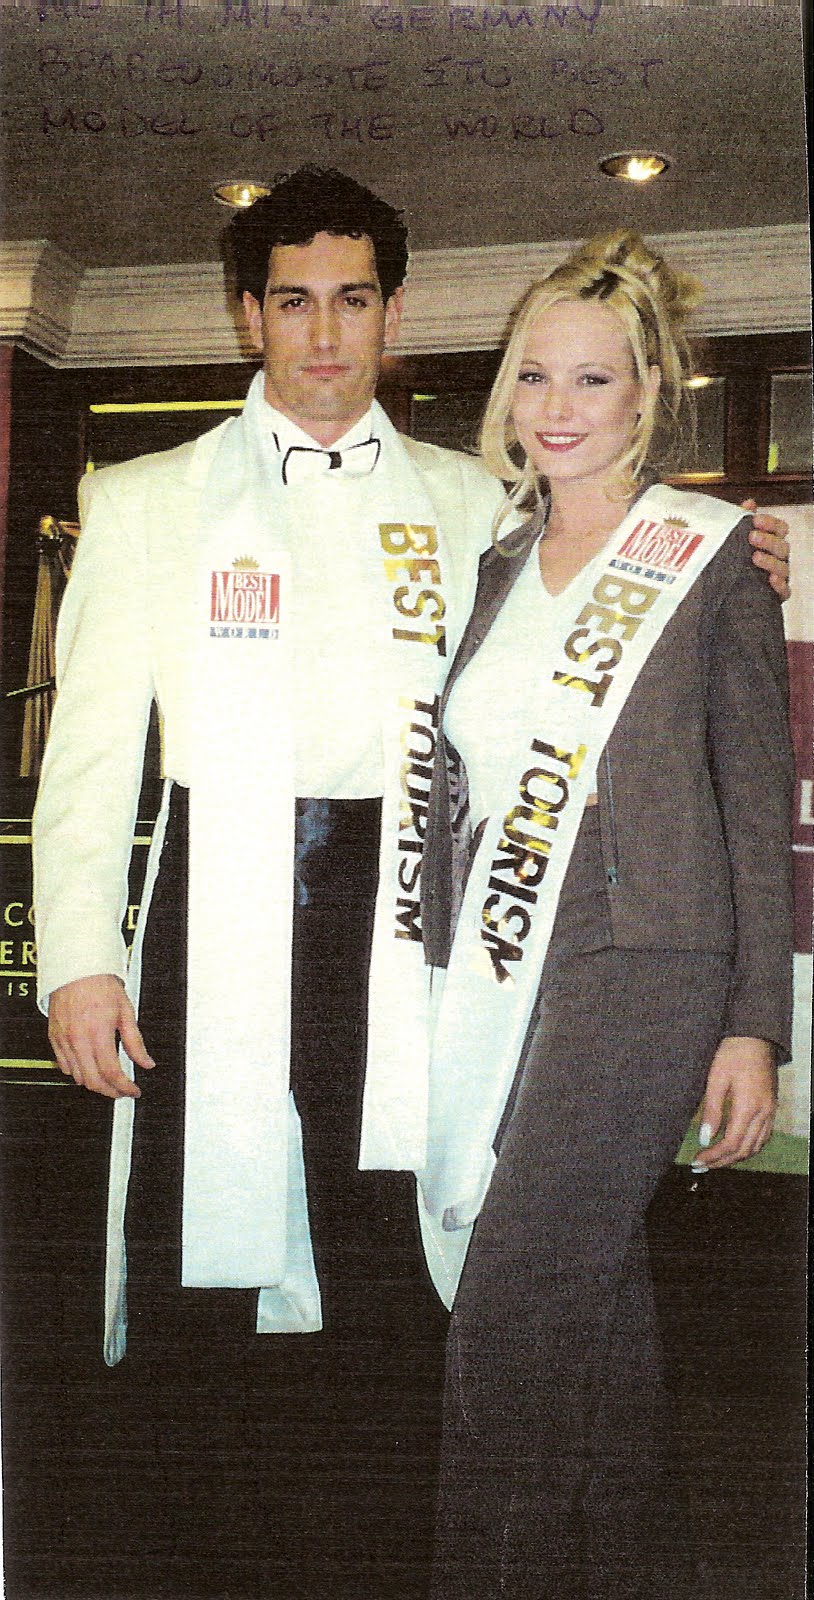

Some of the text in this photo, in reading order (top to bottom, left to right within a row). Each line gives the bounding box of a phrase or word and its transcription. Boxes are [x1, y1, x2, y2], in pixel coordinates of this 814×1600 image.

[42, 106, 605, 142] MODEL OF THE WORLD
[621, 520, 697, 572] MODEL
[213, 571, 279, 623] MODEL
[234, 572, 265, 591] BEST
[378, 522, 447, 657] BEST
[552, 573, 661, 707] BEST
